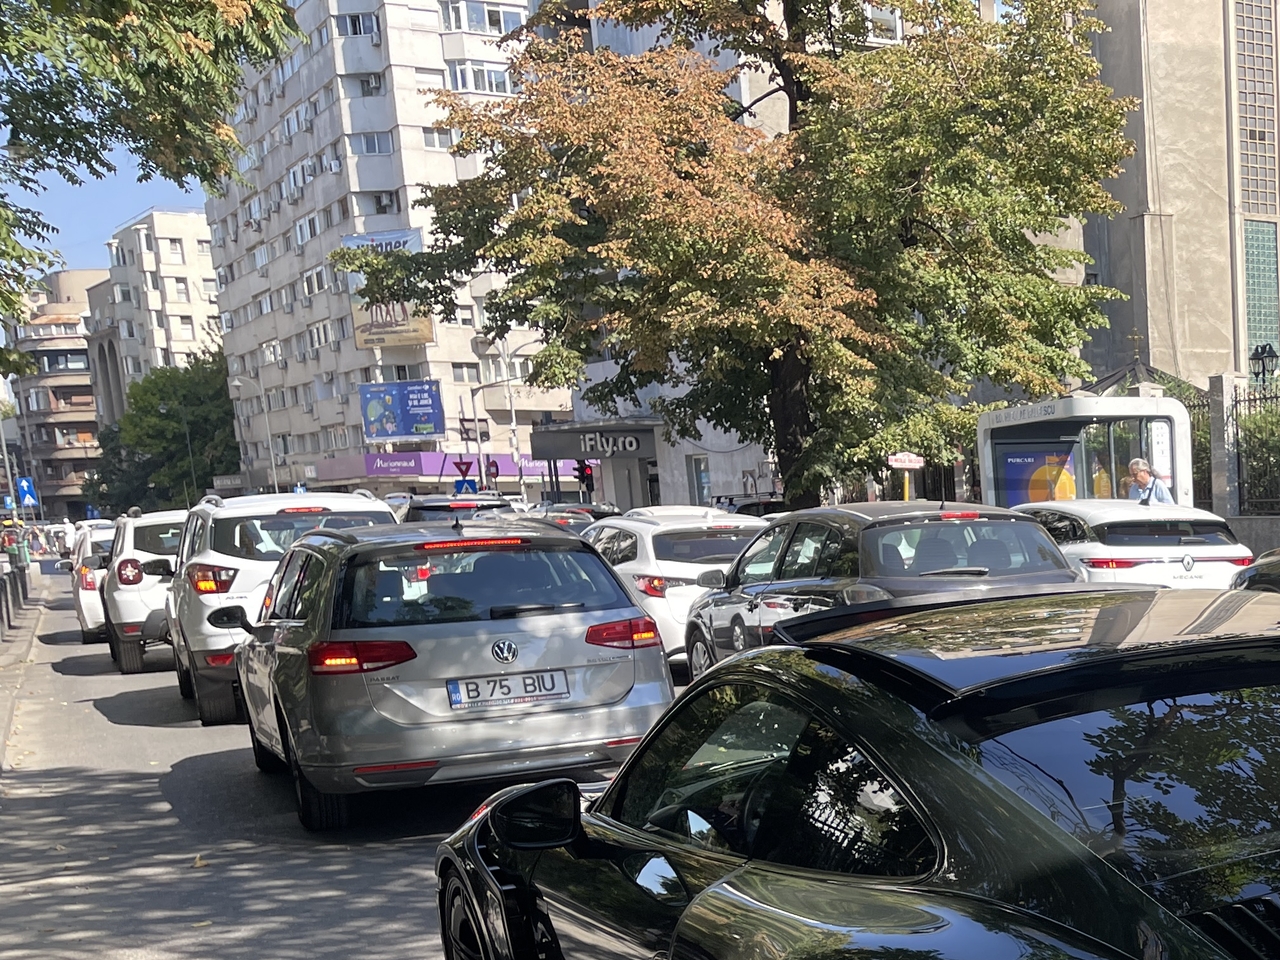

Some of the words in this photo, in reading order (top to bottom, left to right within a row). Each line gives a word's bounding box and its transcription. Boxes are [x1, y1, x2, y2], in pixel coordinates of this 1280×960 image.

[580, 432, 637, 457] iFly.ro
[373, 458, 416, 469] Marionnaud
[465, 681, 480, 700] B
[486, 678, 512, 698] 75
[522, 673, 556, 694] BIU
